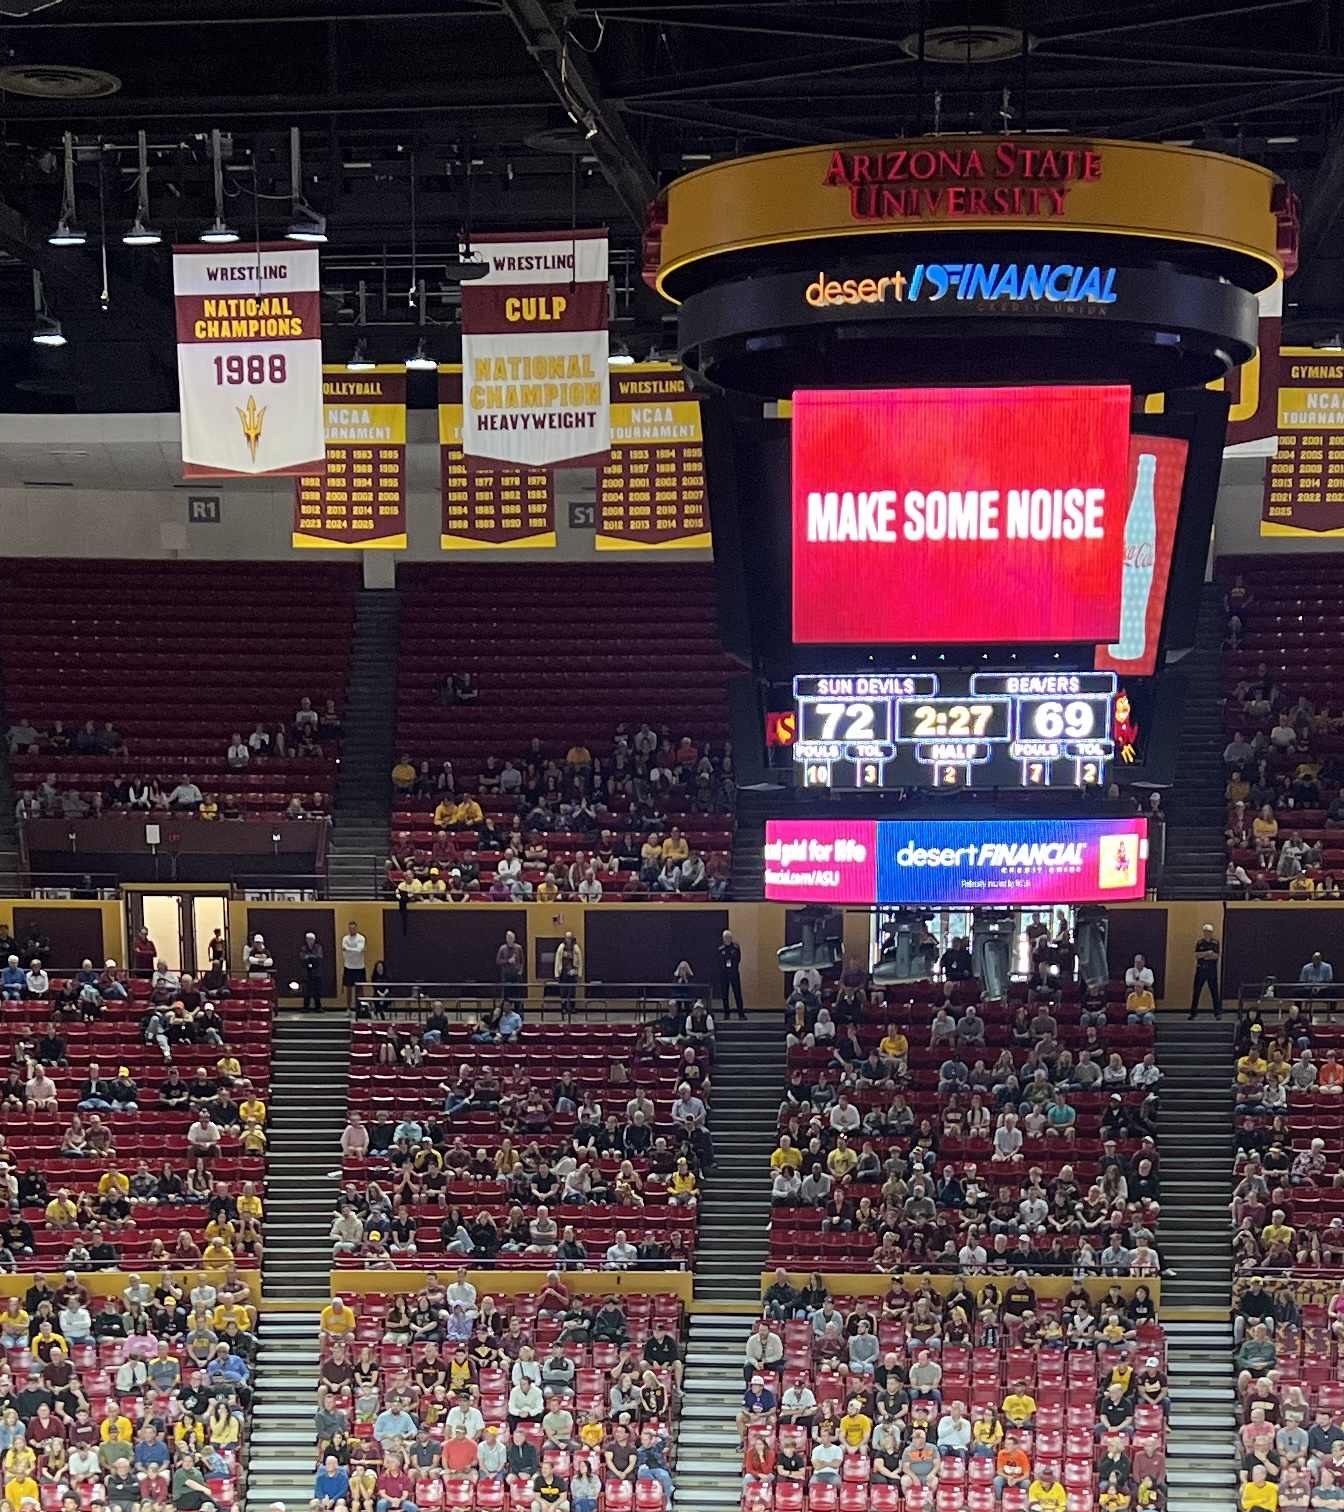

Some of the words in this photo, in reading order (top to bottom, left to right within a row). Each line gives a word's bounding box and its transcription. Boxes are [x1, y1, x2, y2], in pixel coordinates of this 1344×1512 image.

[823, 150, 985, 186] ARIZONA
[996, 142, 1103, 180] STATE
[849, 185, 1070, 220] UNIVERSITY
[493, 254, 575, 271] WRESTLING
[206, 265, 288, 281] WRESTLING
[806, 270, 906, 307] desert
[203, 297, 293, 318] NATIONAL
[505, 296, 567, 322] CULP
[194, 317, 303, 339] CHAMPIONS
[213, 354, 287, 386] 1988
[474, 354, 595, 382] NATIONAL
[323, 382, 383, 395] OLLEYBALL
[469, 382, 602, 410] CHAMPION
[619, 380, 685, 394] WRESTLING
[328, 409, 371, 424] NCAA
[477, 411, 597, 431] HEAVYWEIGHT
[631, 407, 674, 423] NCAA
[324, 426, 392, 440] URNAMENT
[610, 424, 696, 439] TOURNAMENT
[192, 500, 216, 519] R1
[574, 507, 594, 524] S1
[807, 490, 897, 542] MAKE
[904, 490, 999, 541] SOME
[1007, 488, 1105, 539] NOISE
[817, 678, 857, 695] SUN
[860, 678, 915, 695] DEVILS
[1007, 677, 1079, 694] BEAVERS
[815, 703, 875, 740] 72
[913, 705, 993, 737] 2:27
[1034, 702, 1094, 738] 69
[931, 744, 976, 759] HALF
[807, 765, 827, 782] 10
[864, 765, 876, 782] 3
[944, 765, 955, 782] 2
[1029, 764, 1042, 782] 7
[1083, 764, 1095, 782] 2
[809, 839, 832, 862] for
[834, 839, 867, 862] life
[896, 840, 977, 867] desert
[977, 843, 1083, 866] FINANCIAL
